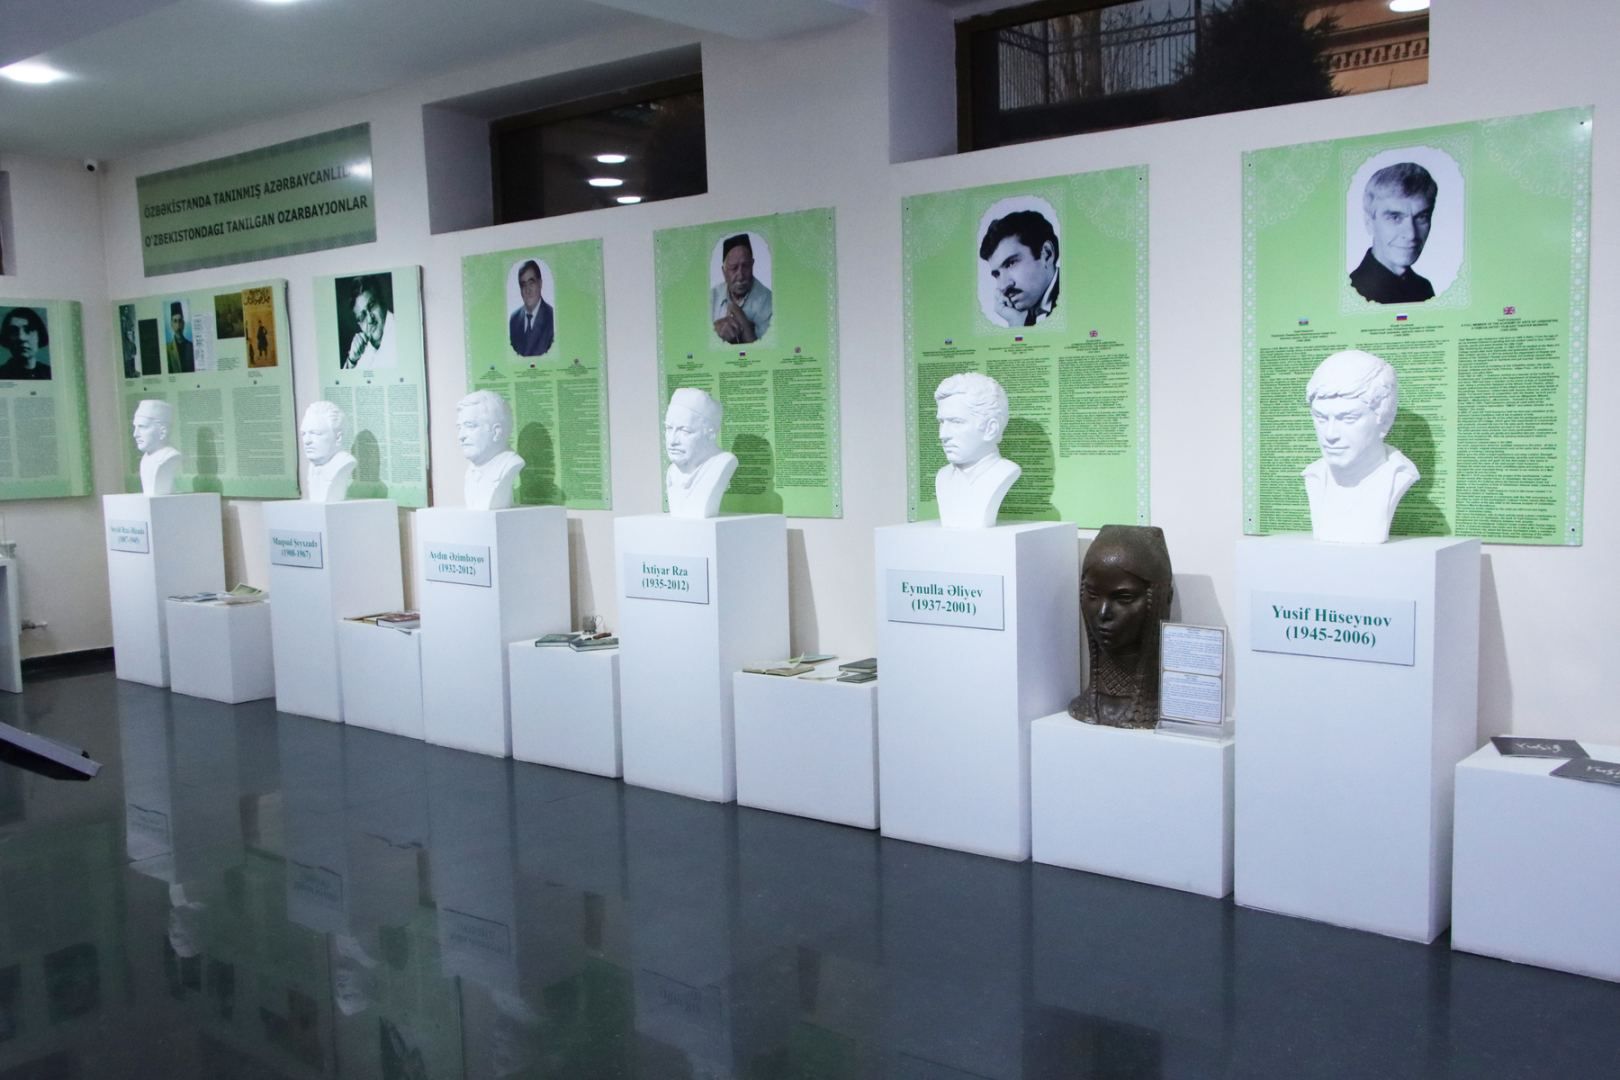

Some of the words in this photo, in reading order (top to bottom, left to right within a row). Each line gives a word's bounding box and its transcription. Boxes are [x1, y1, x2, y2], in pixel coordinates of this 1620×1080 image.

[213, 183, 261, 204] TANINMIŞ
[264, 165, 351, 194] AZƏRBAYCANLIL
[145, 223, 225, 247] O'ZBEKISTONDAGI
[226, 213, 275, 233] TANILGAN
[278, 195, 368, 223] OZARBAYJONLAR
[672, 565, 688, 576] Rza
[642, 577, 690, 592] (1935-2012)
[901, 581, 943, 597] Eynulla
[947, 584, 983, 600] Əliyev
[911, 598, 977, 615] (1937-2001)
[1272, 605, 1311, 621] Yusif
[1315, 608, 1392, 628] Hüseynov
[1285, 626, 1377, 648] (1945-2006)
